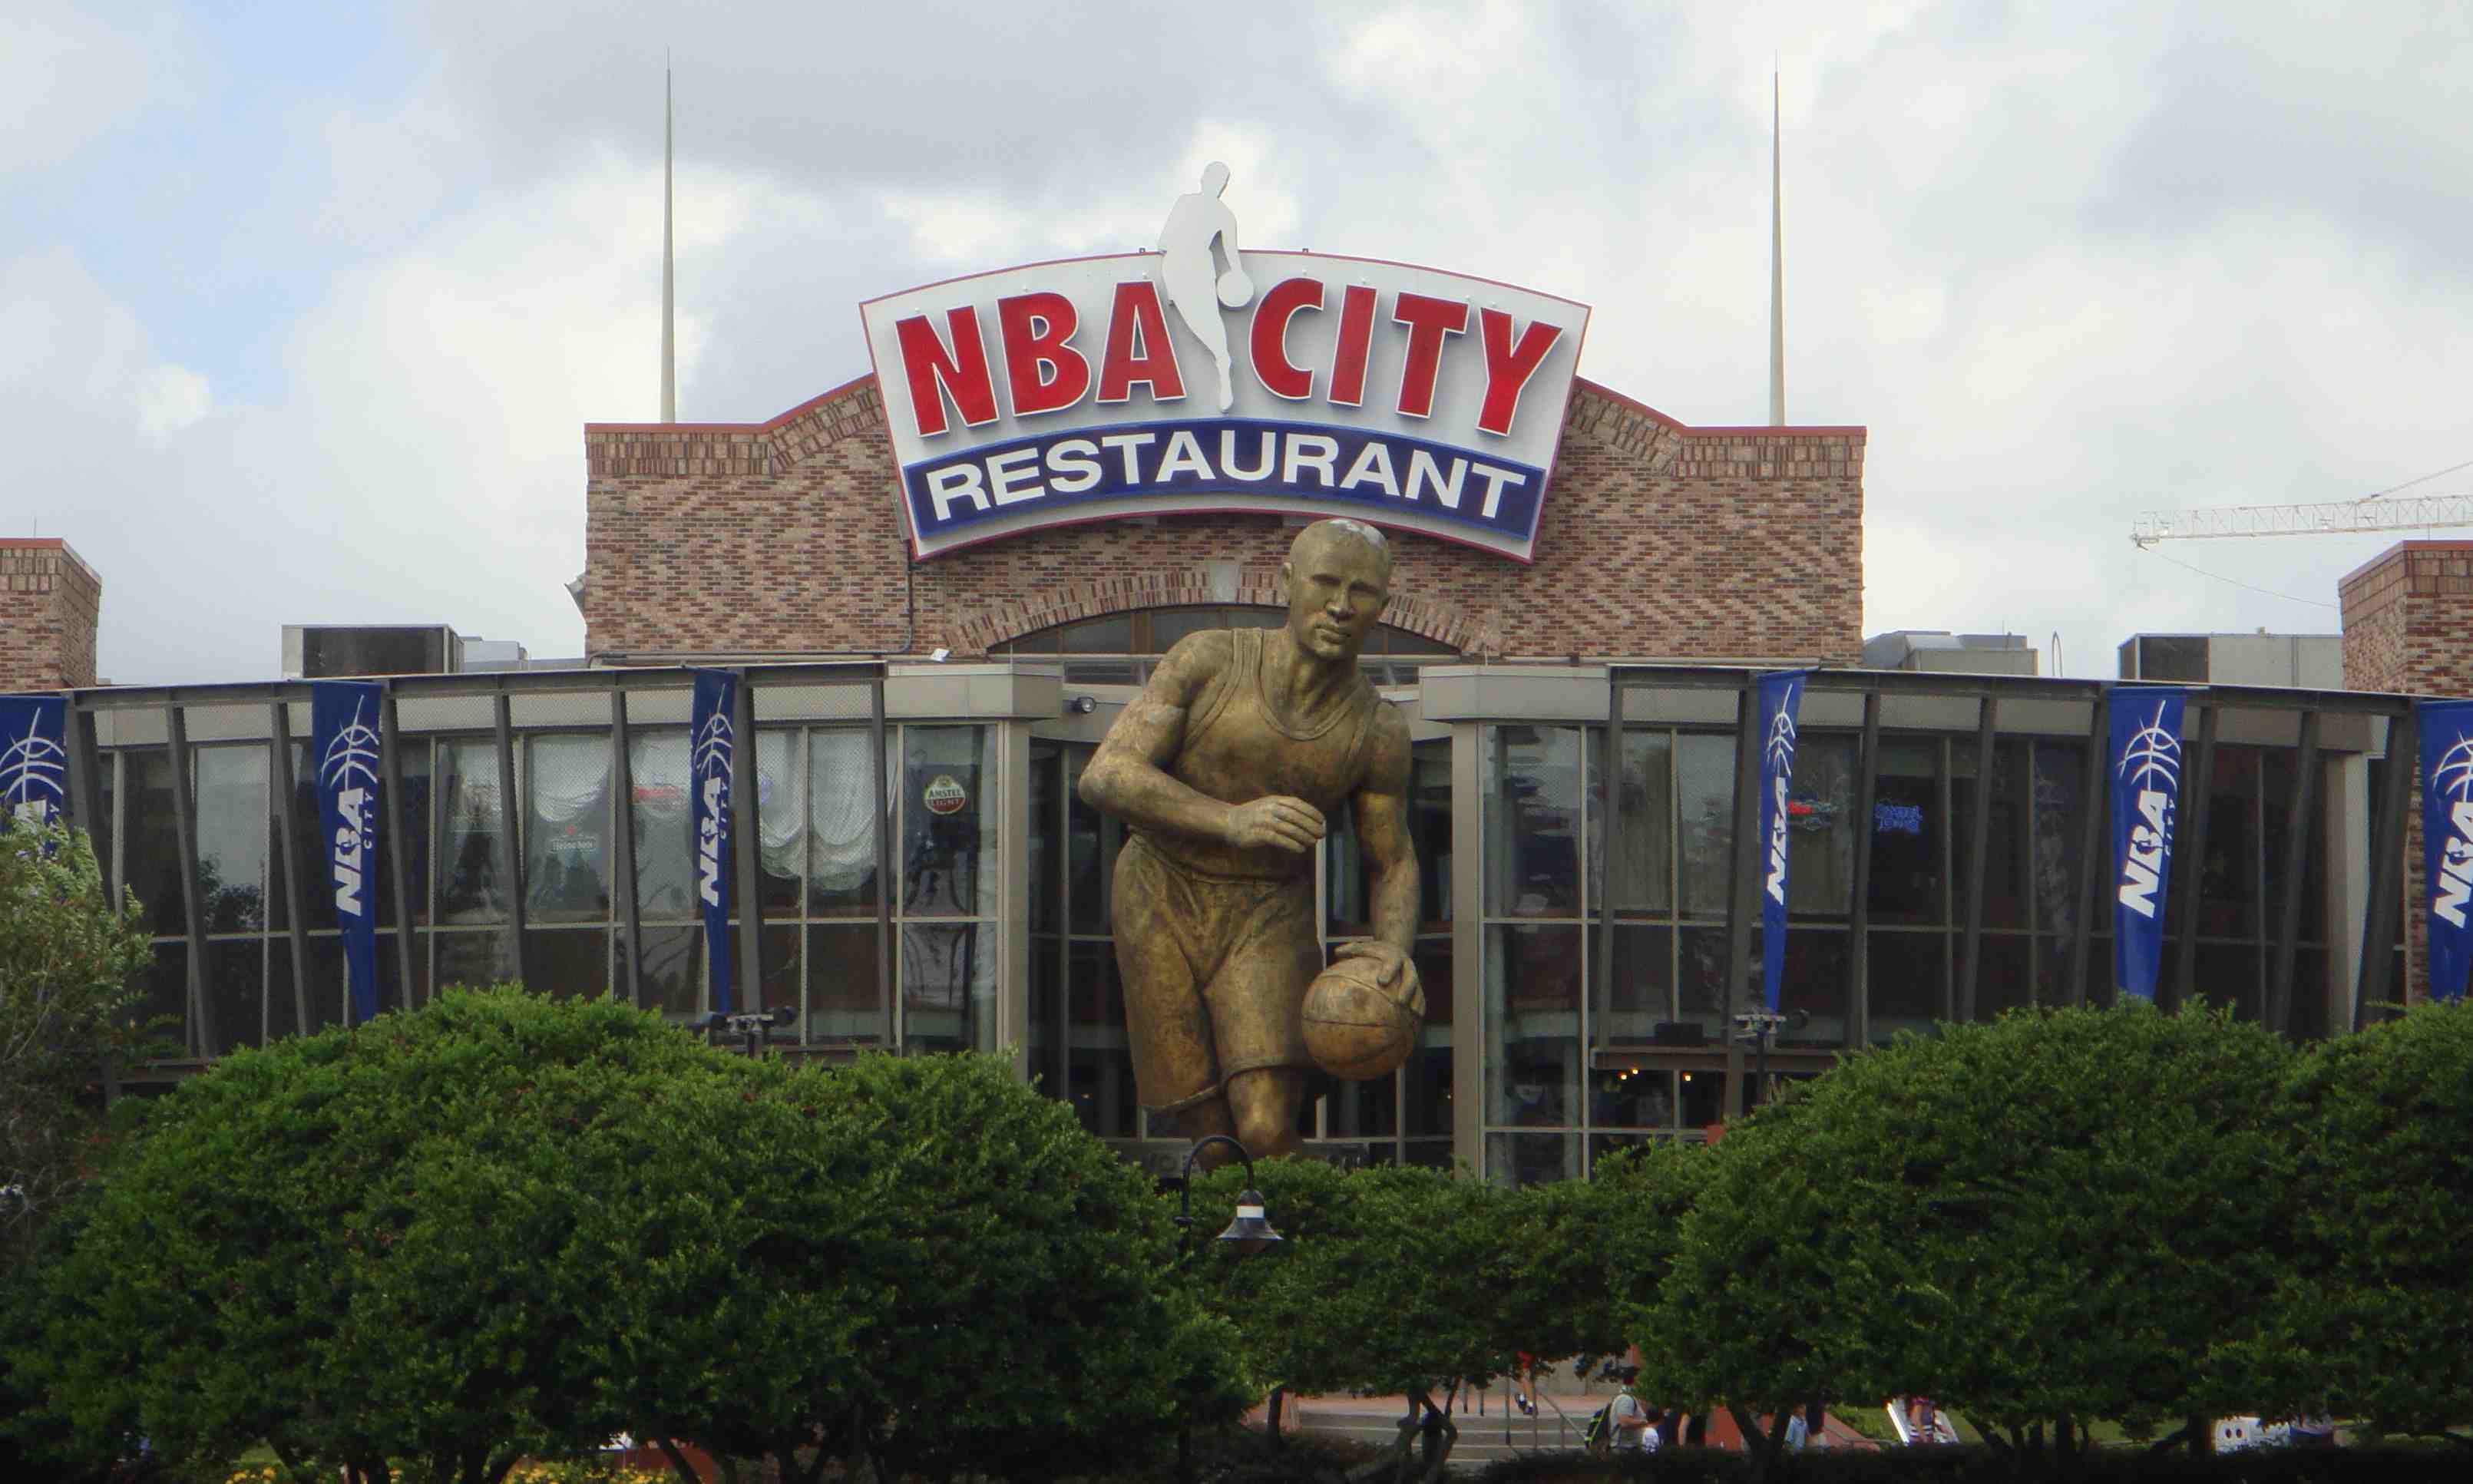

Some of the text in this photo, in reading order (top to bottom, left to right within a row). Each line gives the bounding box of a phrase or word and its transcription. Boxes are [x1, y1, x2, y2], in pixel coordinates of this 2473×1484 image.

[894, 277, 1563, 437] NBA CITY
[925, 431, 1526, 521] RESTAURANT
[335, 788, 363, 916] NBA
[363, 792, 374, 849] CITY
[699, 777, 720, 907] NBA
[1767, 777, 1787, 906] NBA
[2119, 790, 2167, 918] NBA
[2434, 801, 2473, 929] NBA
